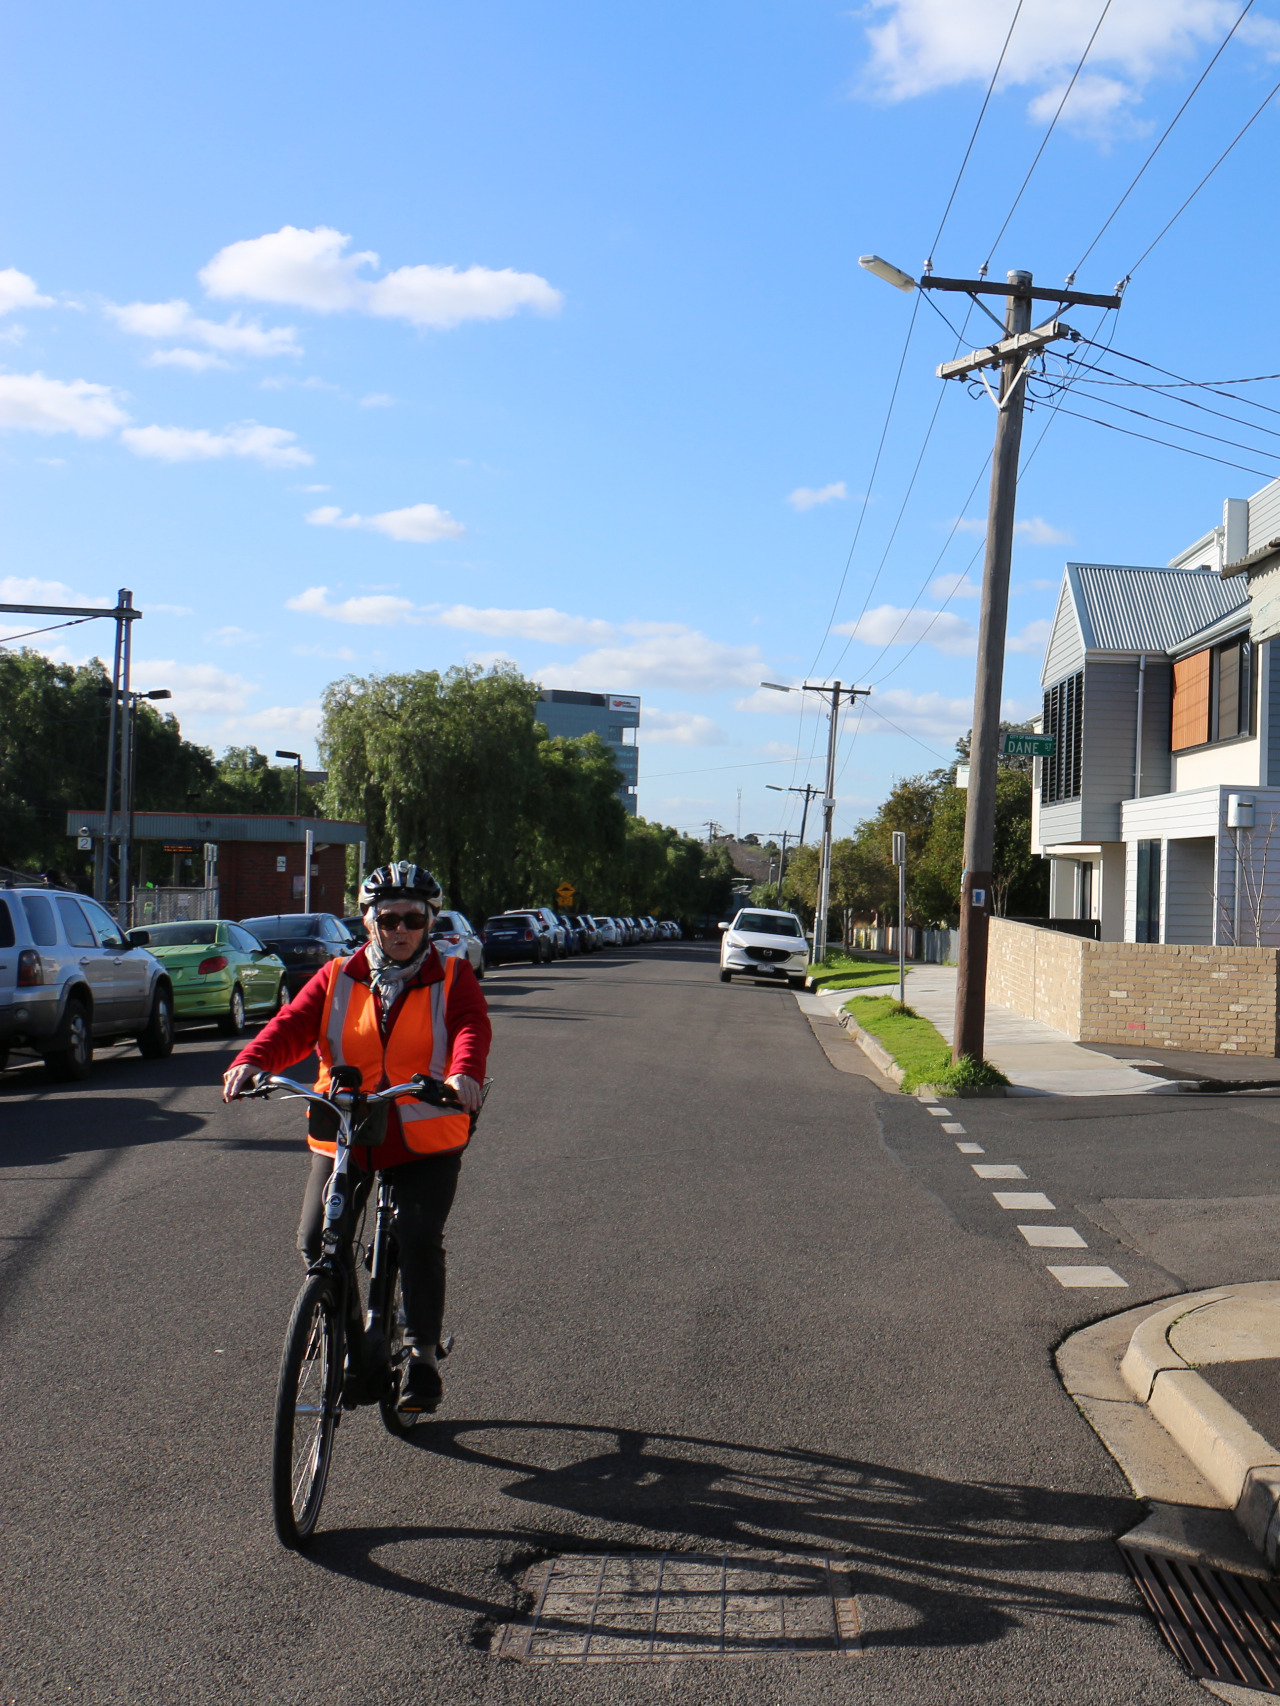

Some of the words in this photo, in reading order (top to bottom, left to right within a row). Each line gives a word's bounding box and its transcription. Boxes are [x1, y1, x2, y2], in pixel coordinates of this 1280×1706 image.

[1008, 741, 1040, 754] DANE
[1044, 743, 1052, 751] ST
[80, 838, 88, 848] 2
